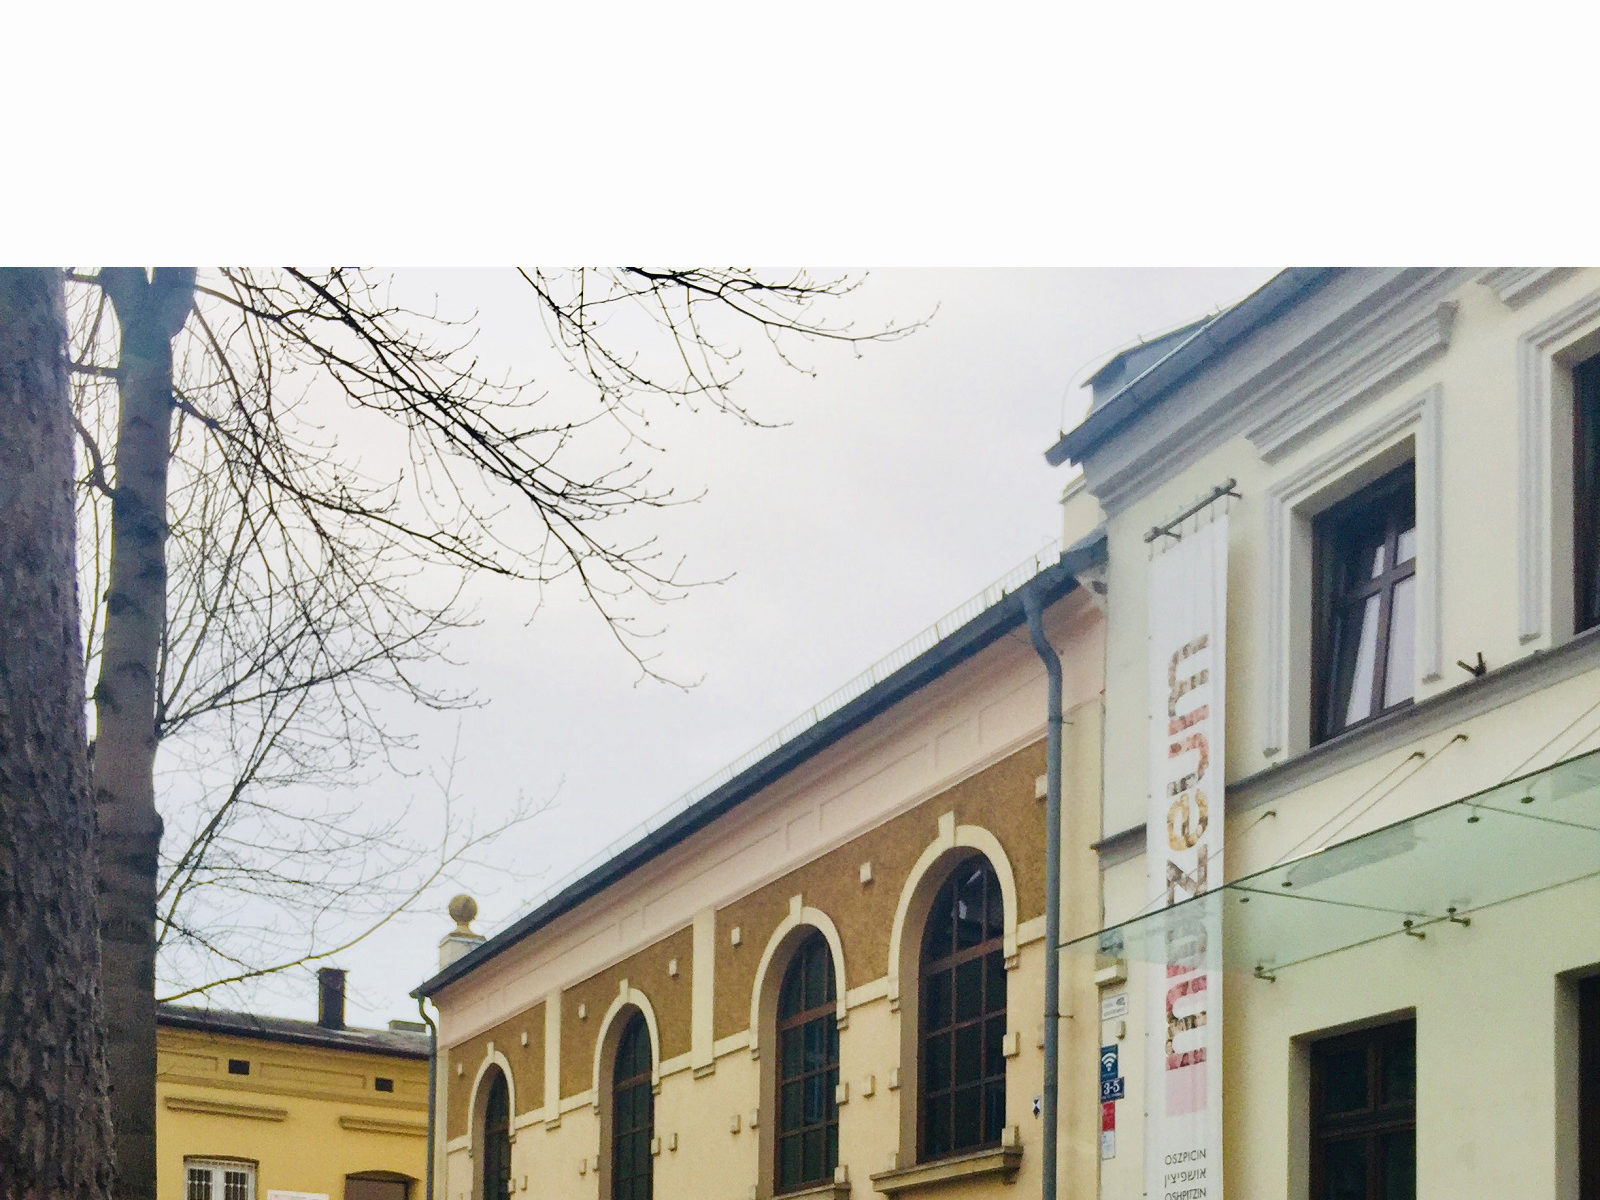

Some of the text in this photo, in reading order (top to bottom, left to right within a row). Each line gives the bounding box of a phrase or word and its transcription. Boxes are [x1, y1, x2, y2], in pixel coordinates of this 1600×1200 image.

[1165, 634, 1209, 1071] muzeum
[1103, 1079, 1120, 1095] 3-5
[1164, 1148, 1207, 1166] OSZPICIN
[1164, 1167, 1207, 1188] אושפיצין
